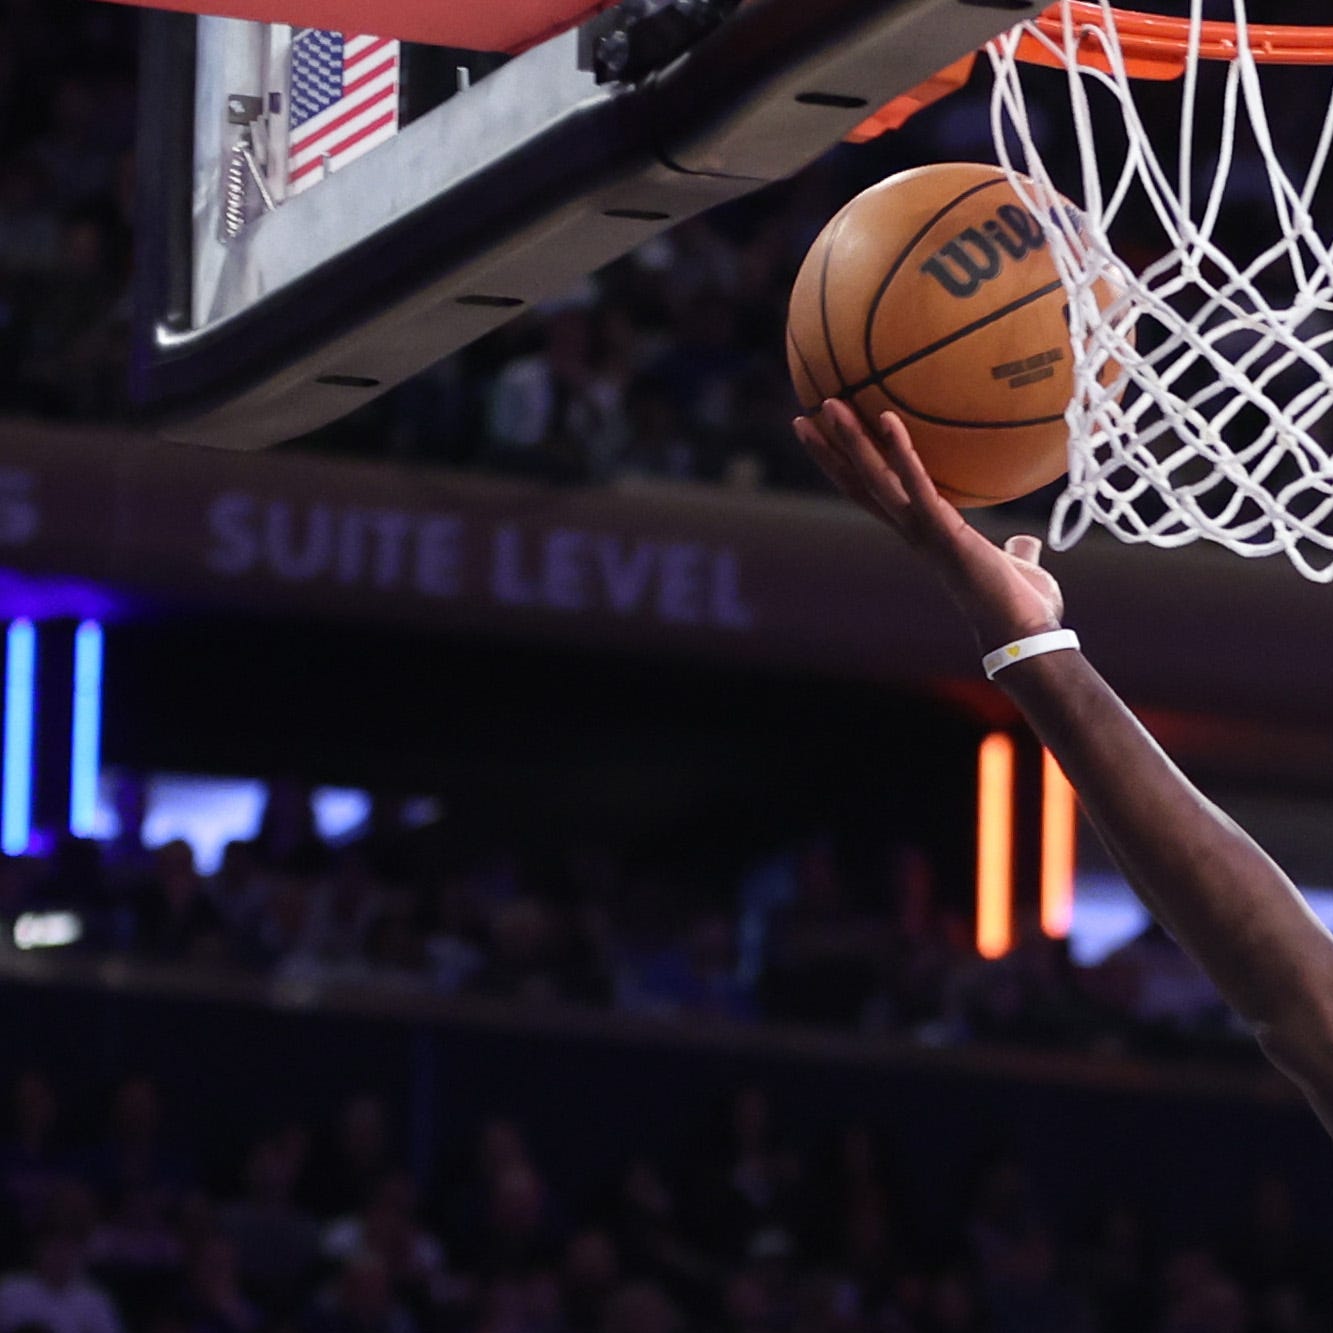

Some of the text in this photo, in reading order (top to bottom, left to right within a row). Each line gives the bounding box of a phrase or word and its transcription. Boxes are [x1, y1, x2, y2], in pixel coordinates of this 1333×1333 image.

[920, 204, 1082, 299] Wil
[206, 492, 756, 629] SUITE LEVEL
